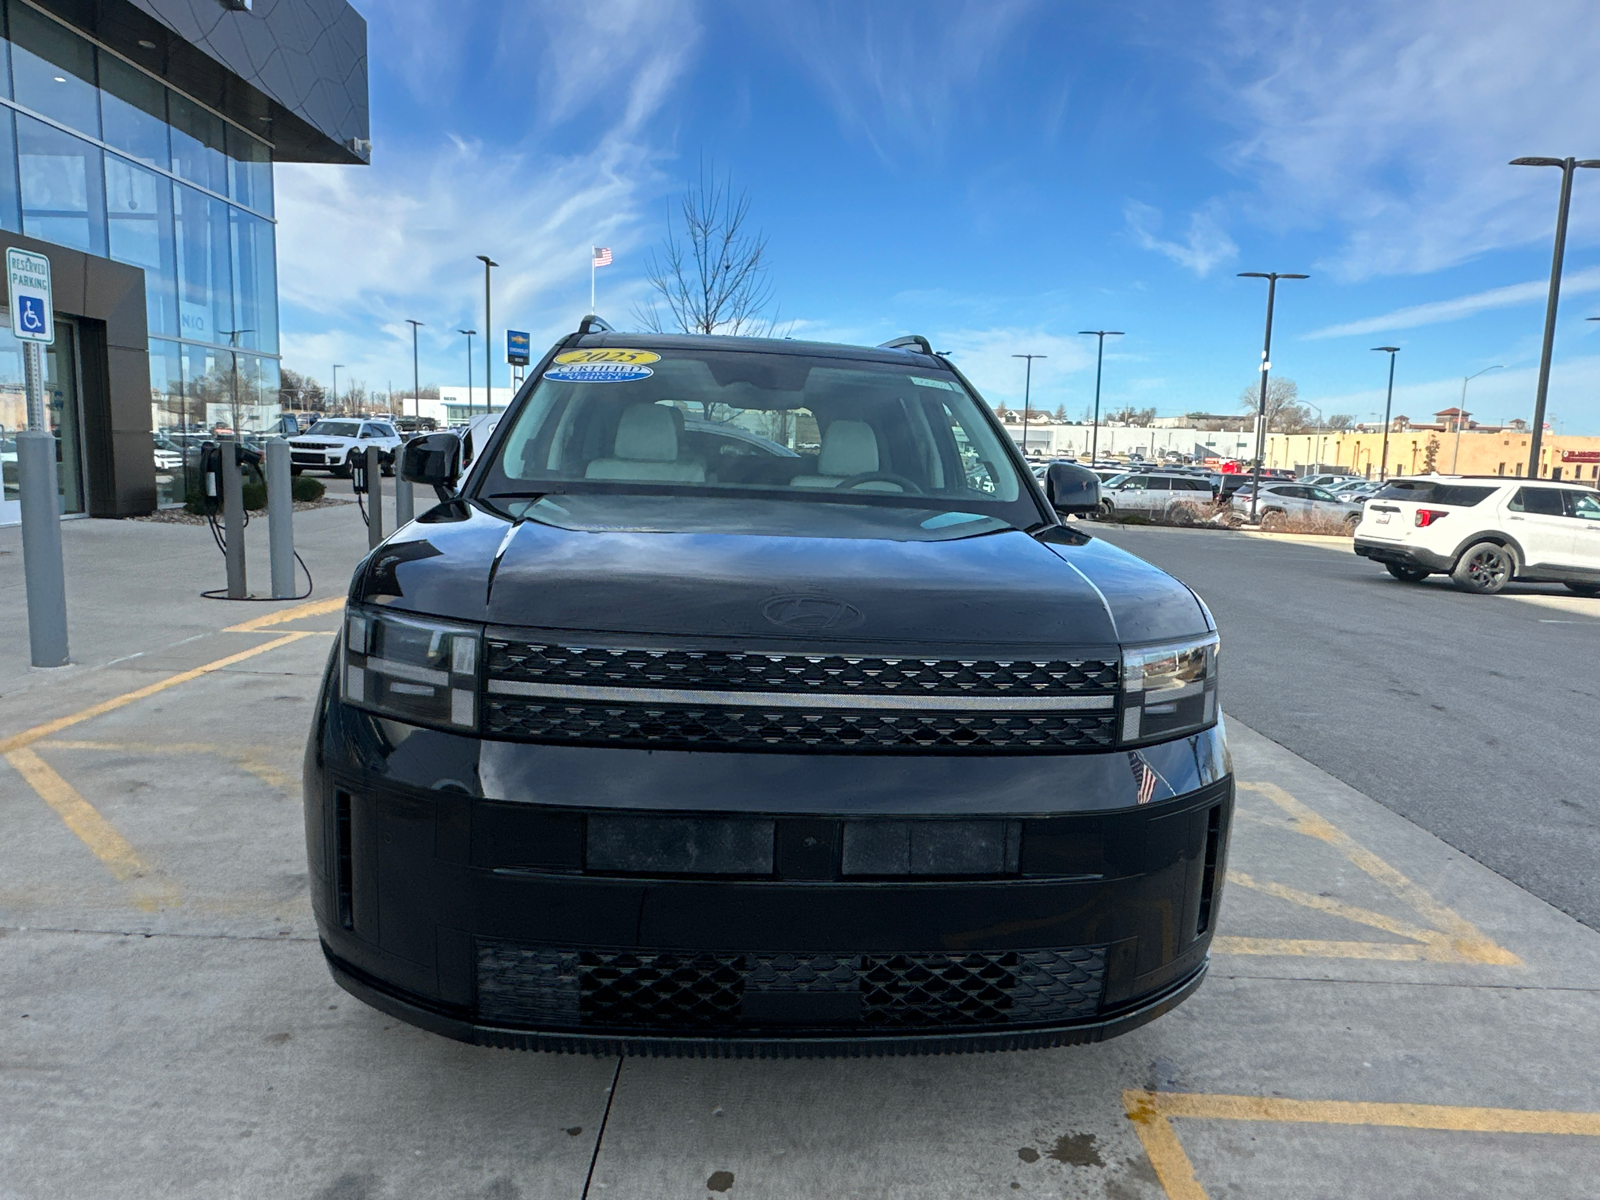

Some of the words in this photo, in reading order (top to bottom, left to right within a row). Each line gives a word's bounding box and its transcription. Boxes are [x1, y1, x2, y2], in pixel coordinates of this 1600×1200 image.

[11, 257, 46, 275] RESERVED
[12, 273, 47, 290] PARKING
[567, 351, 645, 363] 2025
[558, 364, 642, 373] CERTIFIED
